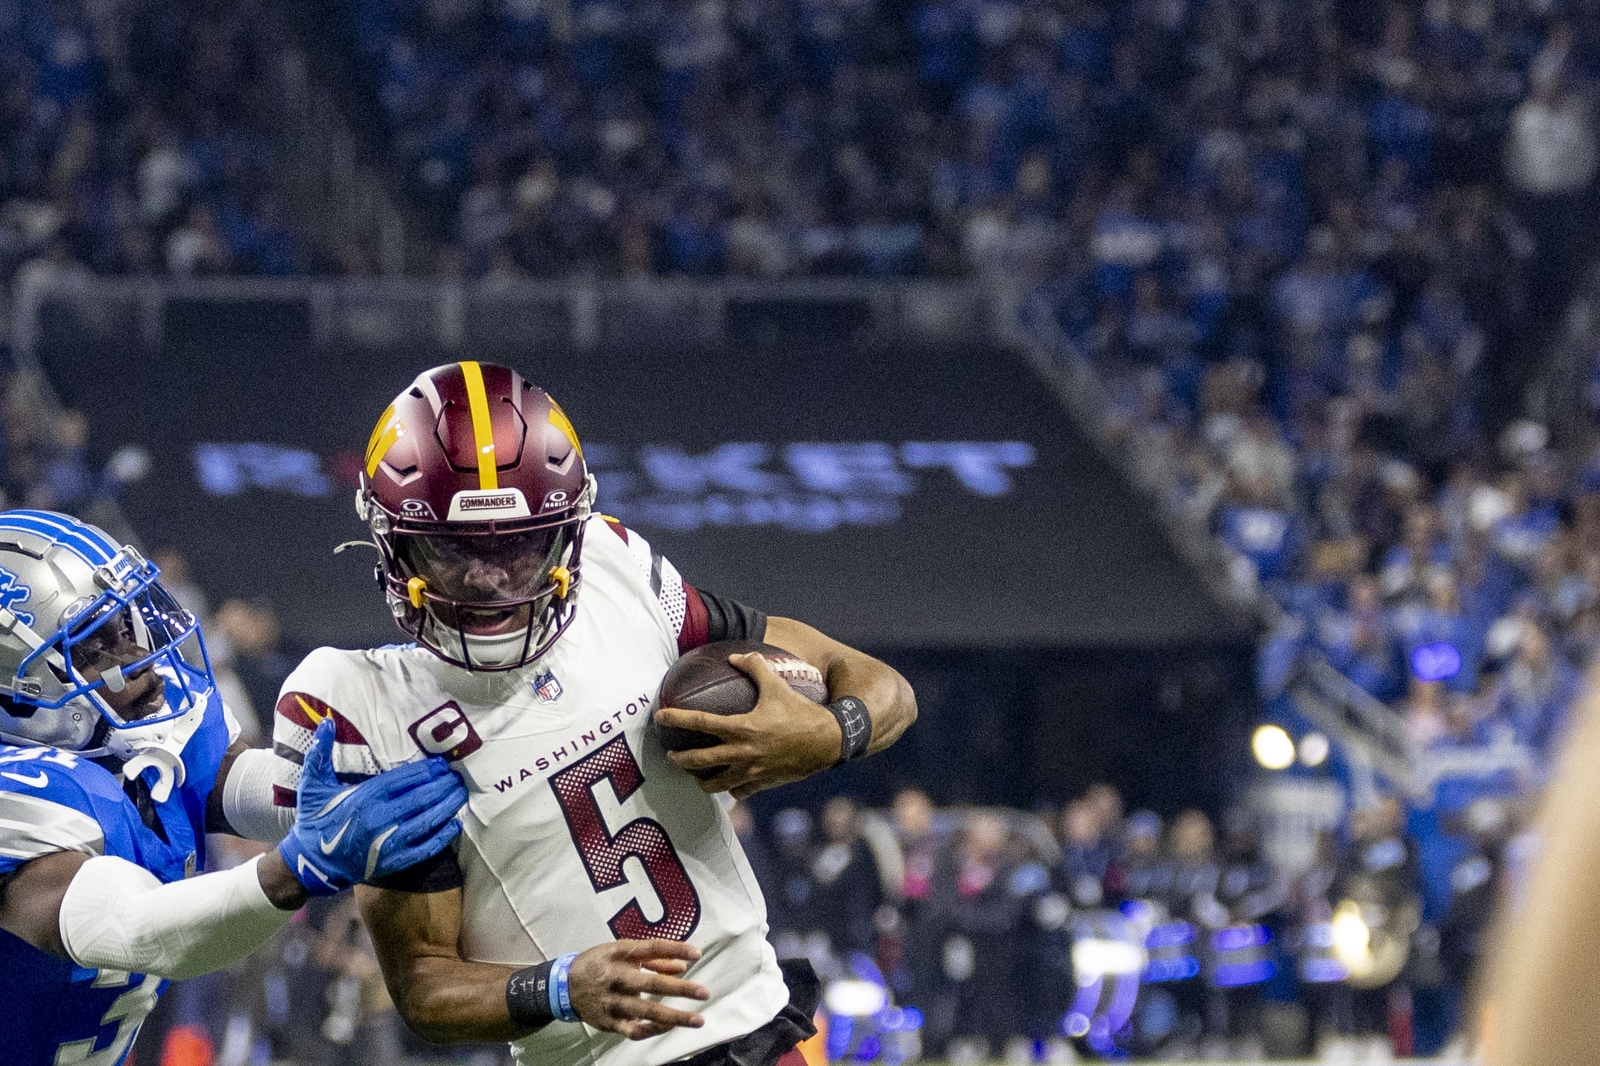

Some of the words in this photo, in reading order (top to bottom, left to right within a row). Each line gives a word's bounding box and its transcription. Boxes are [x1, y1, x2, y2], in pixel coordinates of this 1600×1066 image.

[459, 496, 517, 509] COMMANDERS
[538, 683, 560, 700] NFL
[416, 707, 469, 754] C
[494, 693, 651, 793] WASHINGTON
[547, 730, 702, 942] 5
